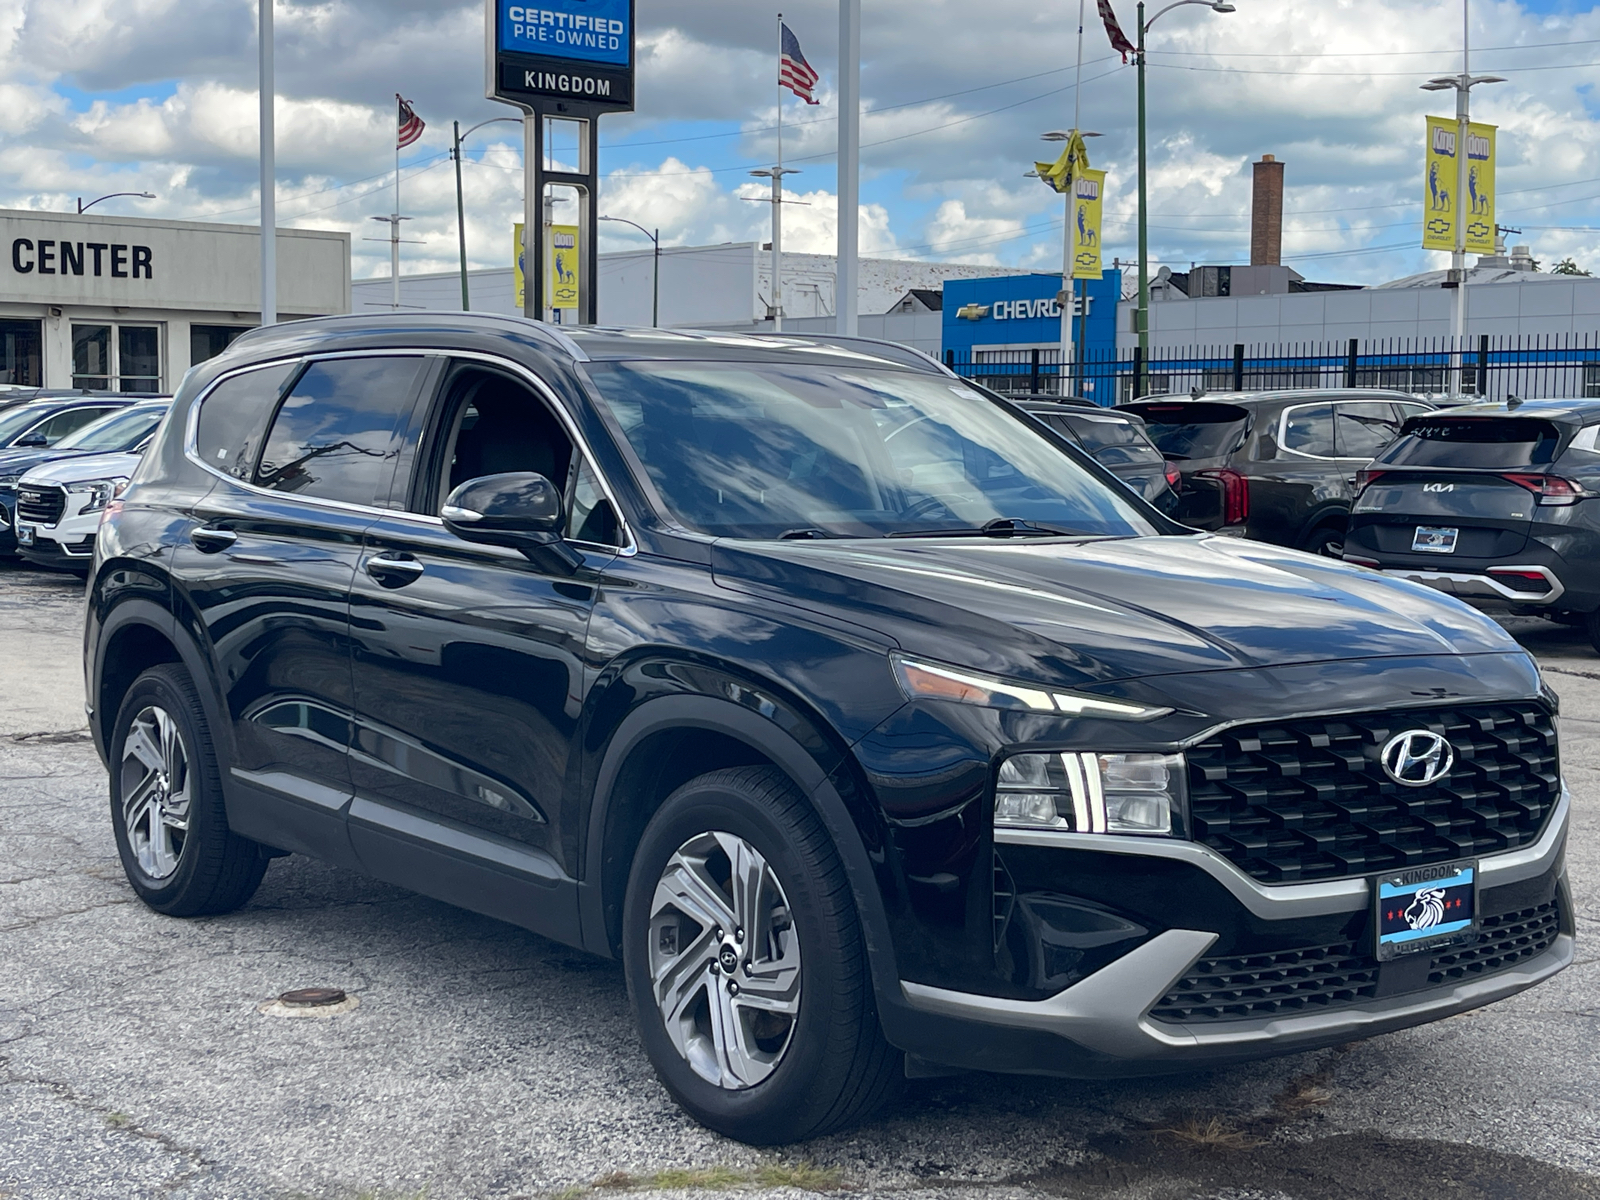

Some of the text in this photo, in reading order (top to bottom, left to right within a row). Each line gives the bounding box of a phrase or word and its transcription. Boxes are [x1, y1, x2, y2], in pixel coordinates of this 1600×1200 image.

[509, 6, 624, 35] CERTIFIED
[514, 23, 619, 50] PRE-OWNED
[524, 70, 611, 96] KINGDOM
[1432, 126, 1456, 155] King
[1467, 132, 1490, 158] dom
[1076, 177, 1099, 199] dom
[554, 232, 575, 247] dom
[12, 238, 153, 279] CENTER
[993, 296, 1094, 320] CHEVROET
[1402, 864, 1457, 885] KINGDOM
